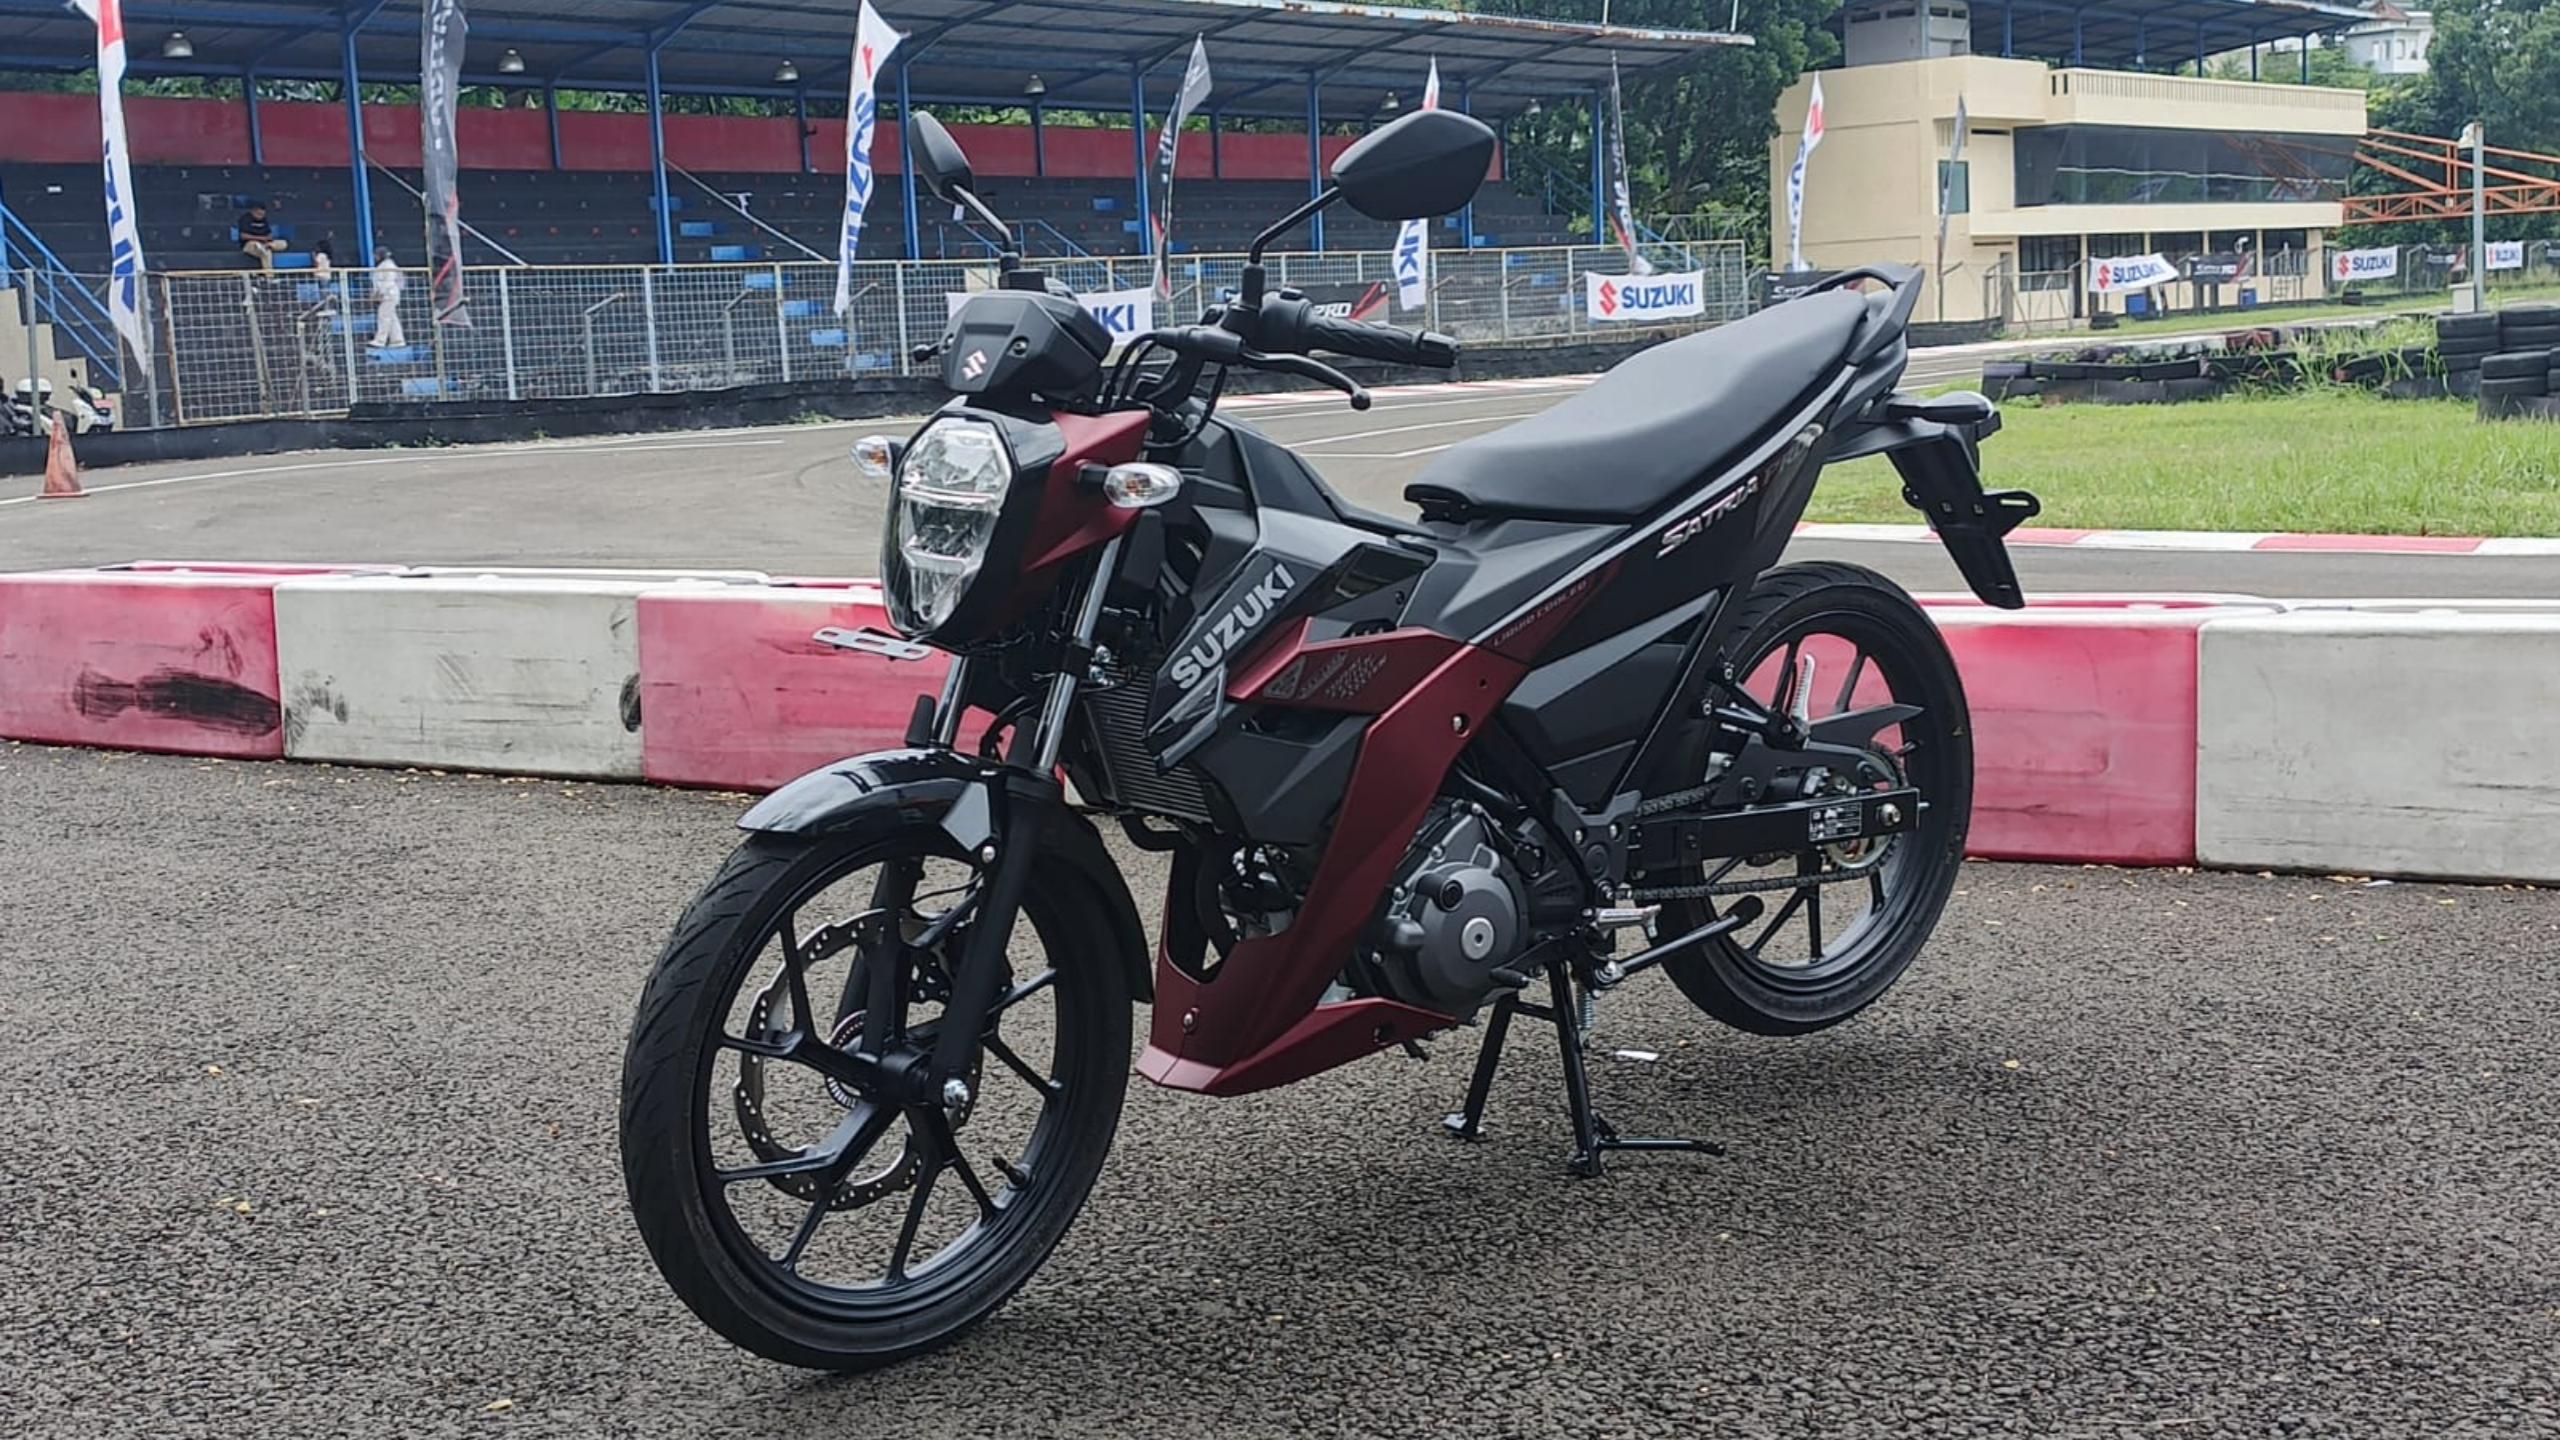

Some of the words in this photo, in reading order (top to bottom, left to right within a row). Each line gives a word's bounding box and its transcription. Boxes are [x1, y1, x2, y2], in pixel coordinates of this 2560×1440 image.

[2352, 254, 2393, 271] SUZUKI
[1621, 284, 1694, 309] SUZUKI
[1656, 475, 1758, 559] SATRIA
[1171, 563, 1296, 689] SUZUKI
